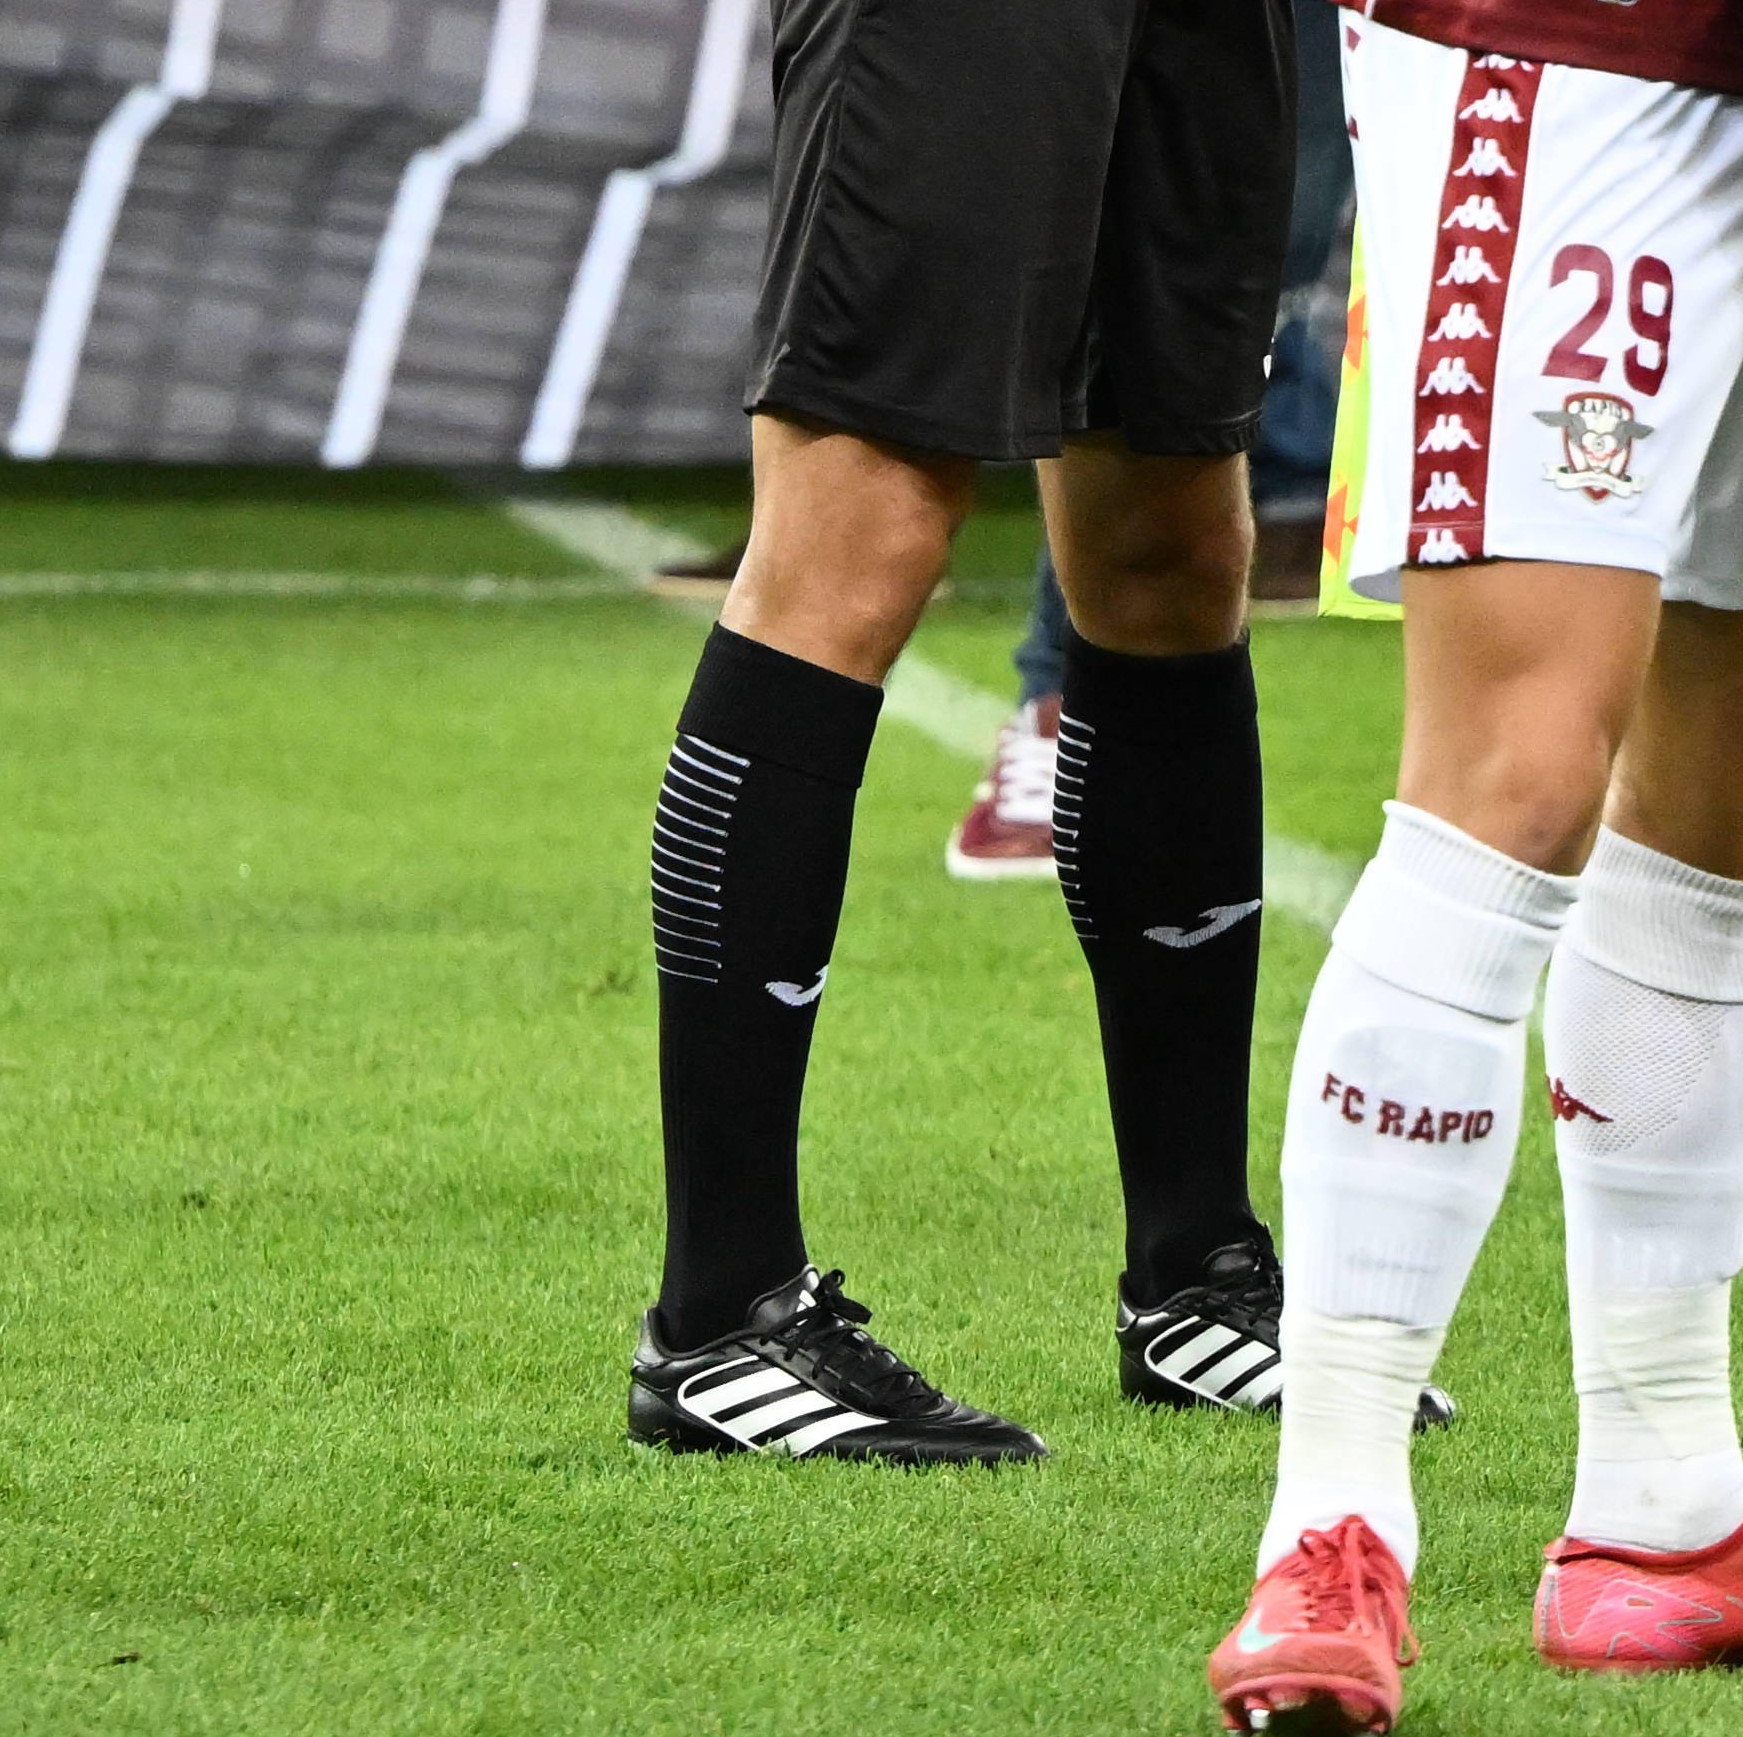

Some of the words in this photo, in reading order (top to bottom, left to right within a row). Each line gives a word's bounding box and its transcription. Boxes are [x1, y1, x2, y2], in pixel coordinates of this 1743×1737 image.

[1541, 243, 1674, 396] 29
[1319, 1072, 1365, 1123] FC
[1375, 1100, 1493, 1144] RAPID
